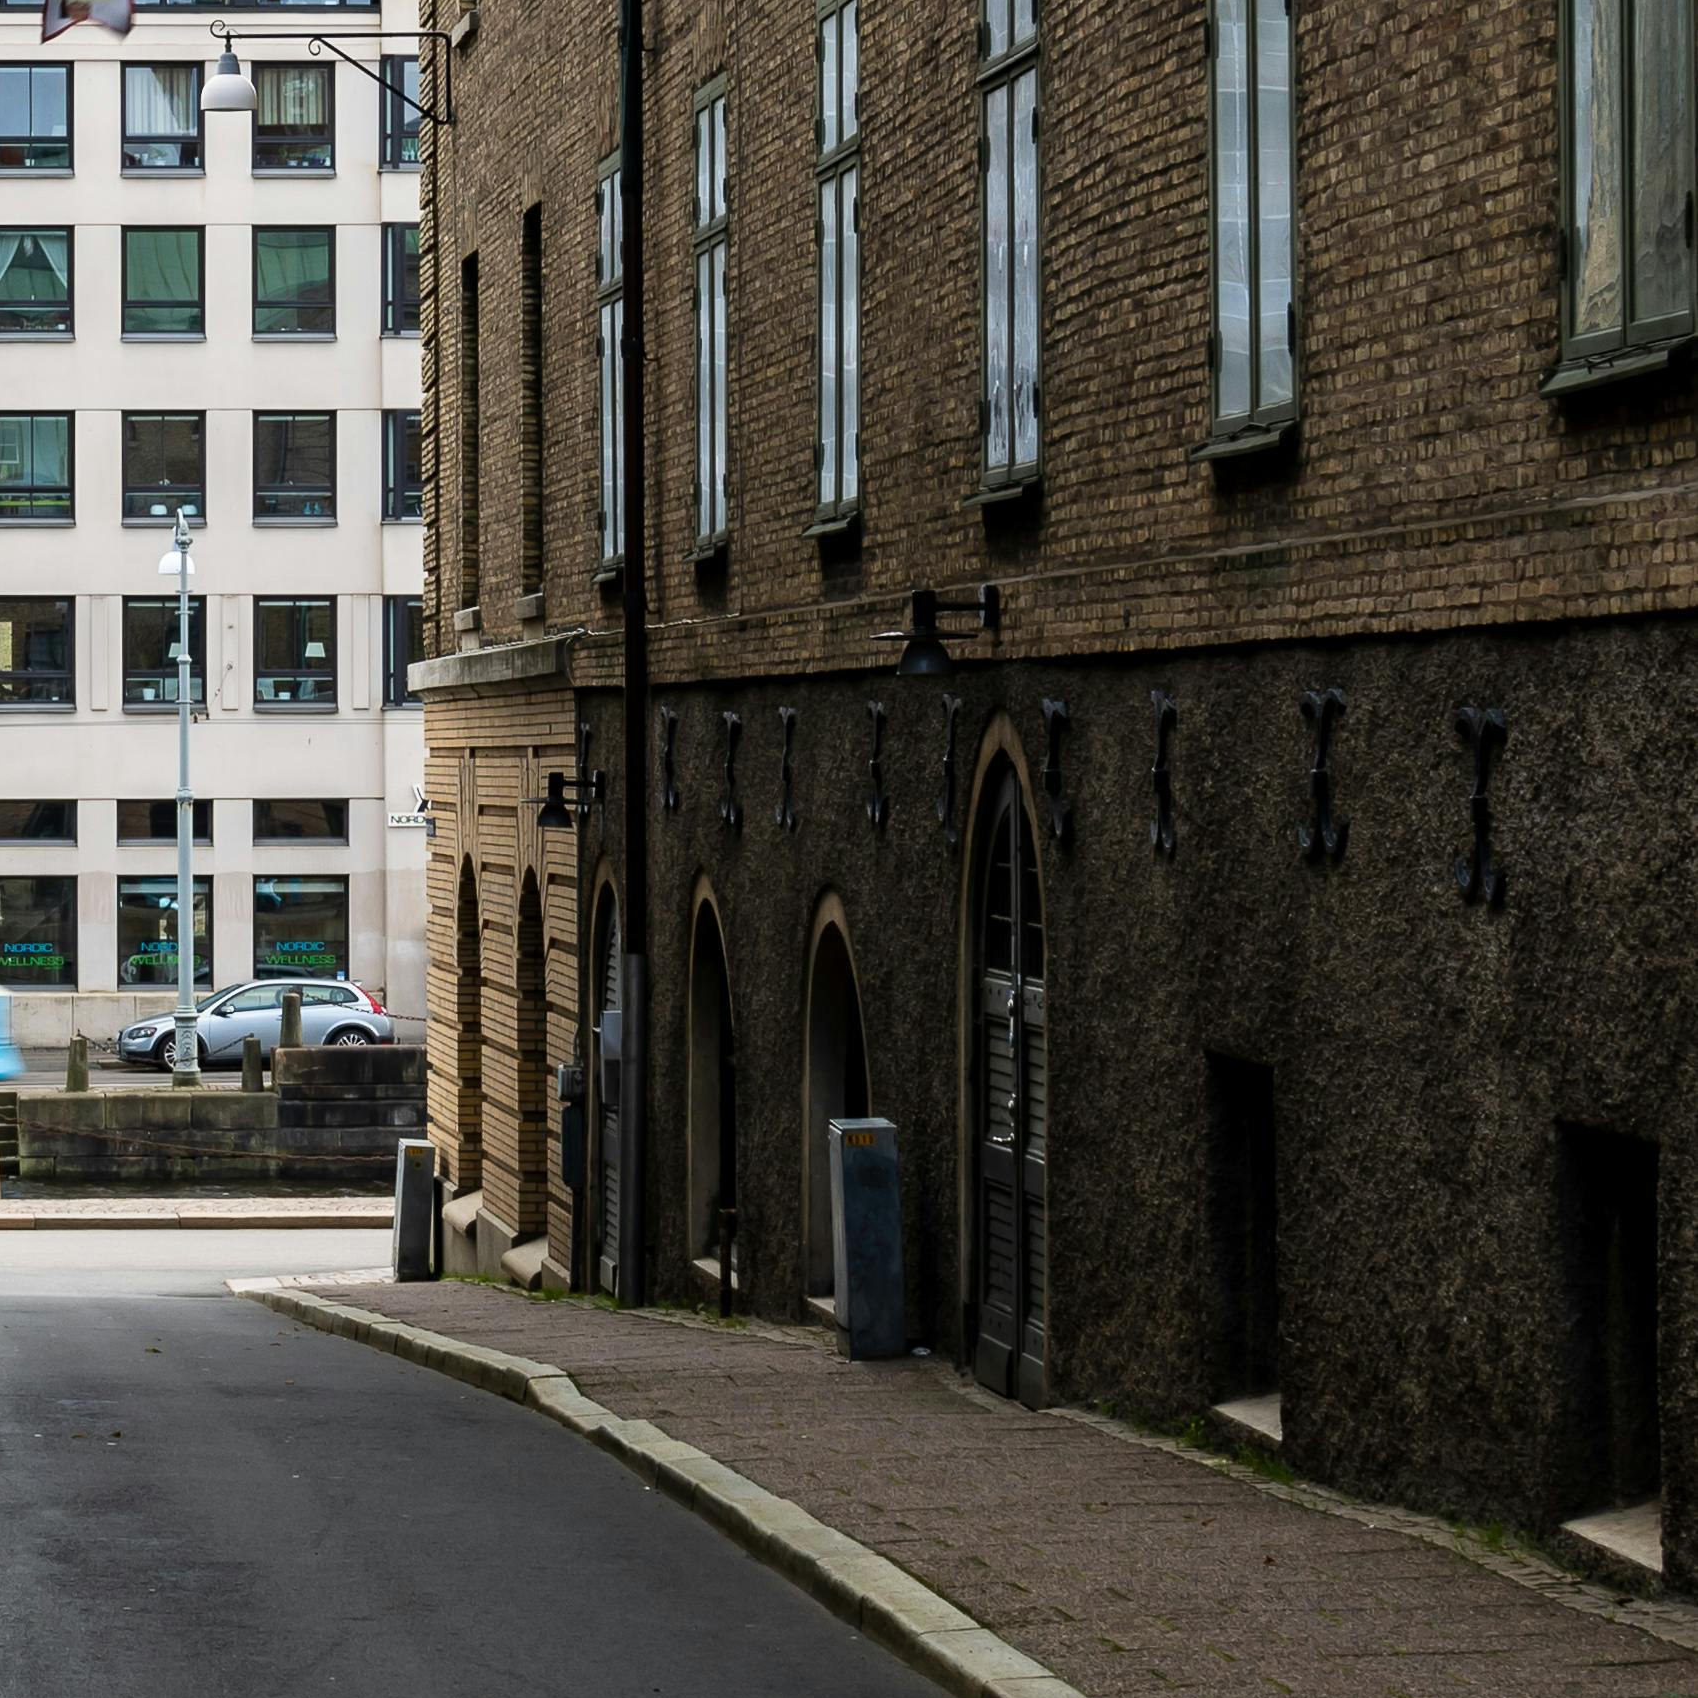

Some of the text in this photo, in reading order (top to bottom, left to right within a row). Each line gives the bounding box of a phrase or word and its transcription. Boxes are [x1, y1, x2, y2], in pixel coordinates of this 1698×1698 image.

[4, 943, 53, 953] NORDIC
[141, 942, 180, 952] NORD
[275, 942, 325, 951] NORDIC
[264, 955, 337, 965] WELLNESS
